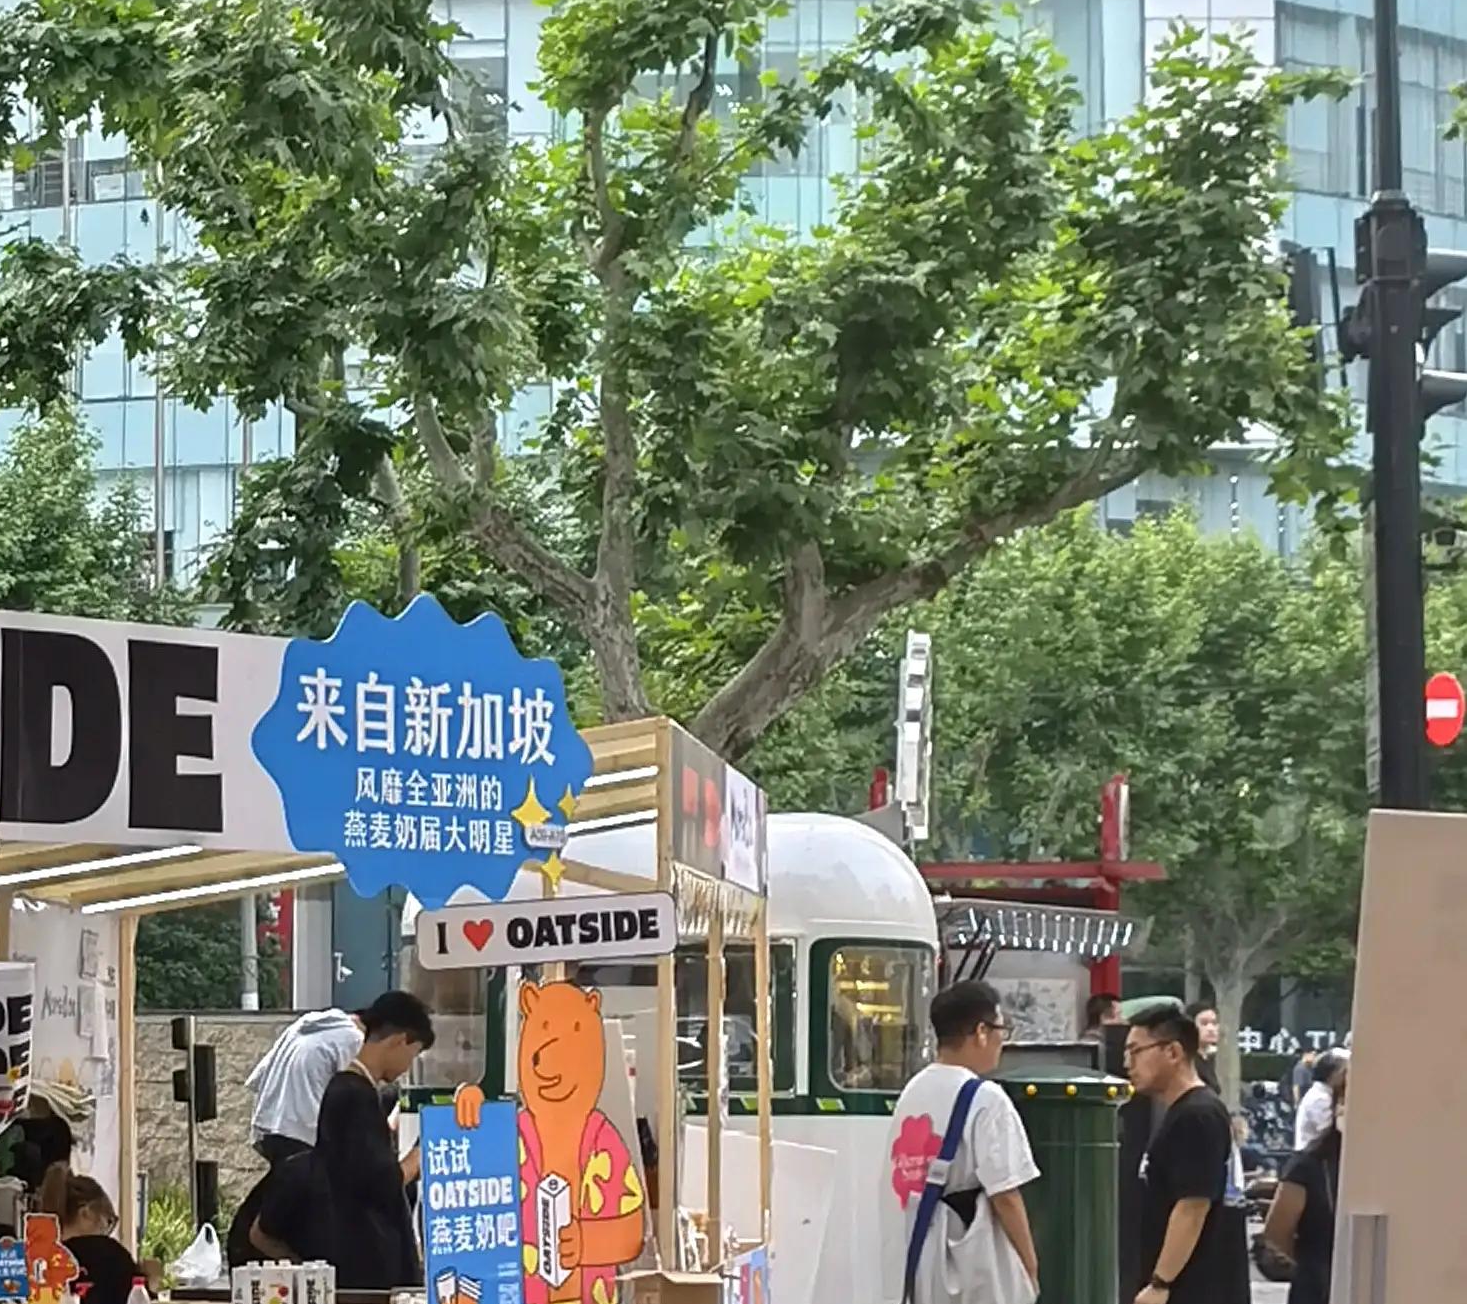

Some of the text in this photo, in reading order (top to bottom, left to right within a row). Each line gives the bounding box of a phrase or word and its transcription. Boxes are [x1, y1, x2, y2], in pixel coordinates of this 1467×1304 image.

[296, 667, 556, 766] 来自新加坡
[355, 768, 503, 811] 风靡全亚洲的
[344, 810, 515, 855] 燕麦奶届大明星
[437, 908, 660, 955] I OATSIDE
[428, 1136, 472, 1176] 试试
[429, 1176, 514, 1211] OATSIDE
[431, 1212, 518, 1255] 燕麦奶吧
